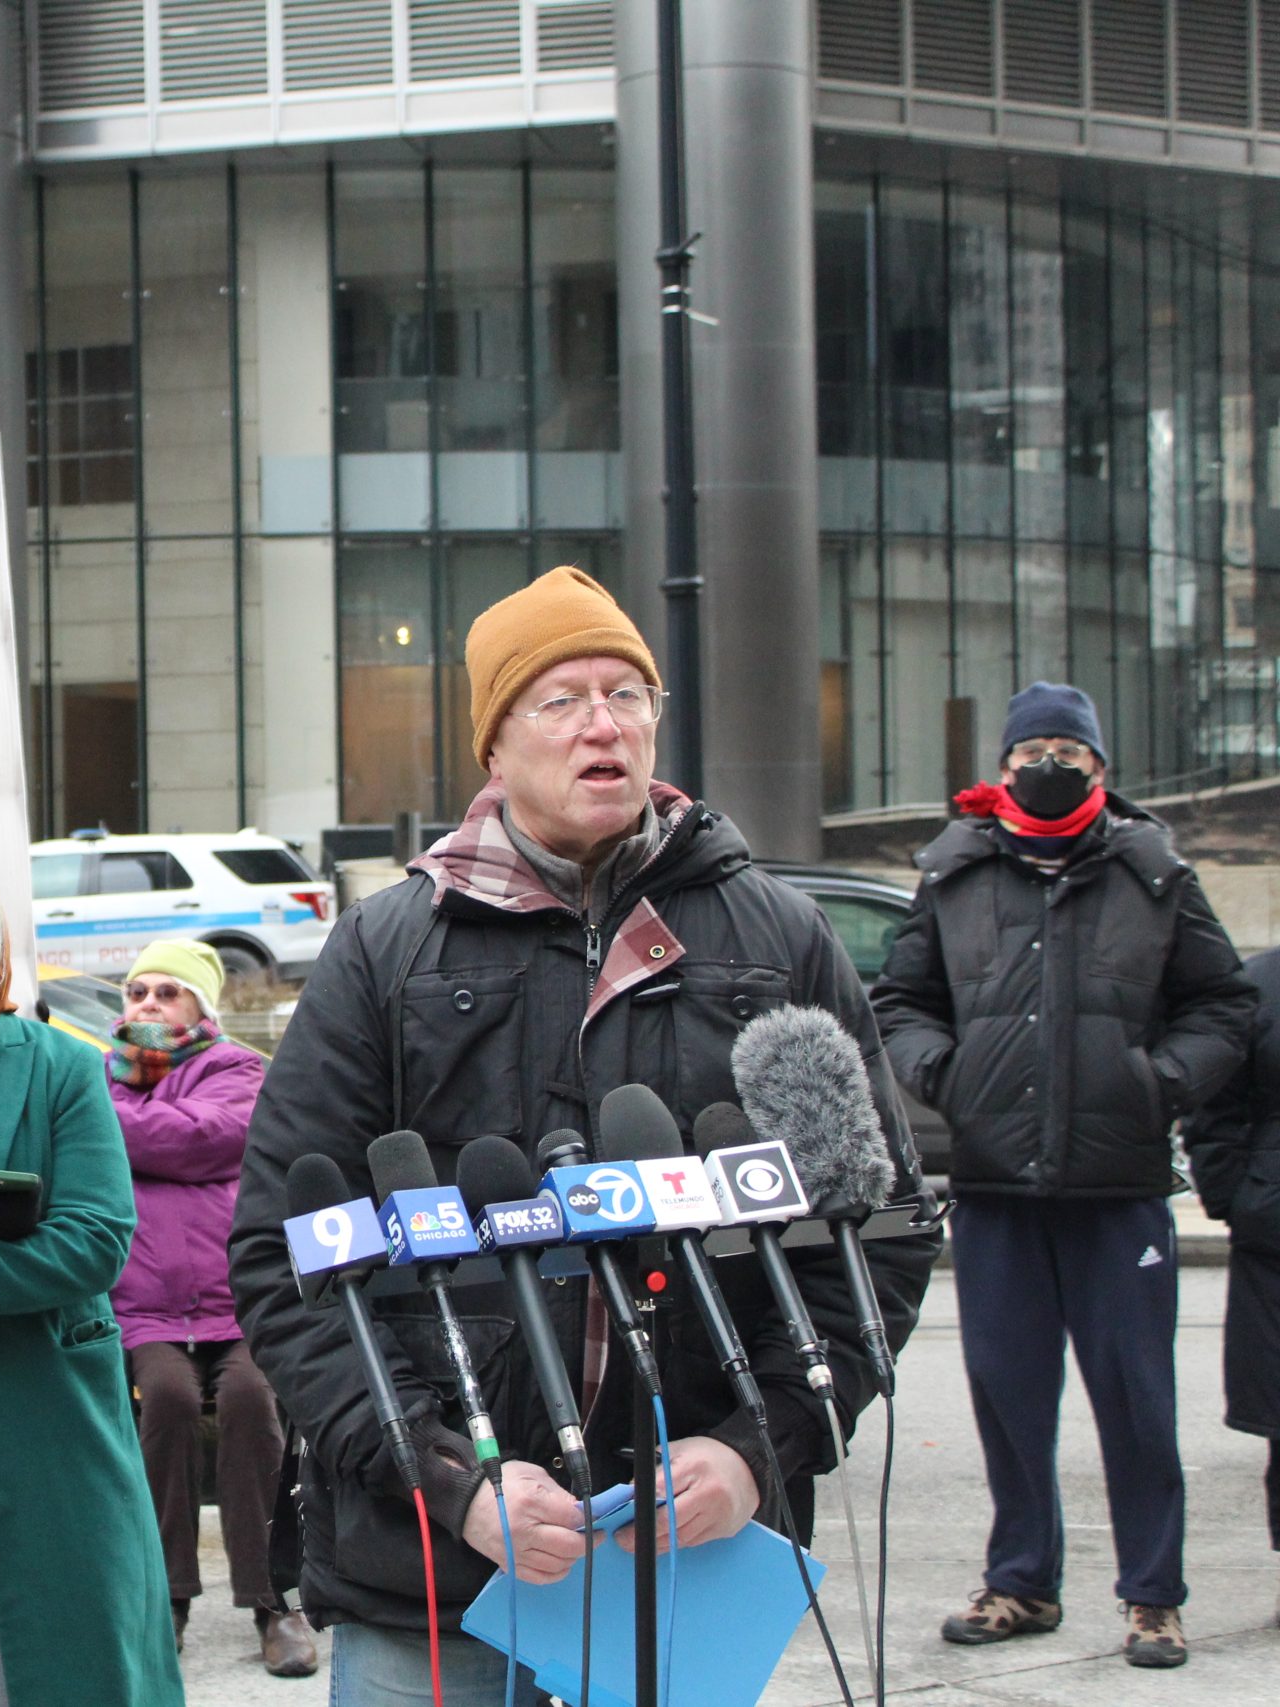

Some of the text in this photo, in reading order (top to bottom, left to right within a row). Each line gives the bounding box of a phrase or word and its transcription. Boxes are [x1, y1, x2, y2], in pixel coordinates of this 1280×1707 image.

[568, 1168, 644, 1222] abc 7
[386, 1211, 403, 1246] 5
[436, 1201, 464, 1230] 5
[492, 1206, 554, 1231] FOX 32
[498, 1223, 557, 1236] CHICAGO
[312, 1207, 353, 1266] 9
[414, 1229, 467, 1241] CHICAGO
